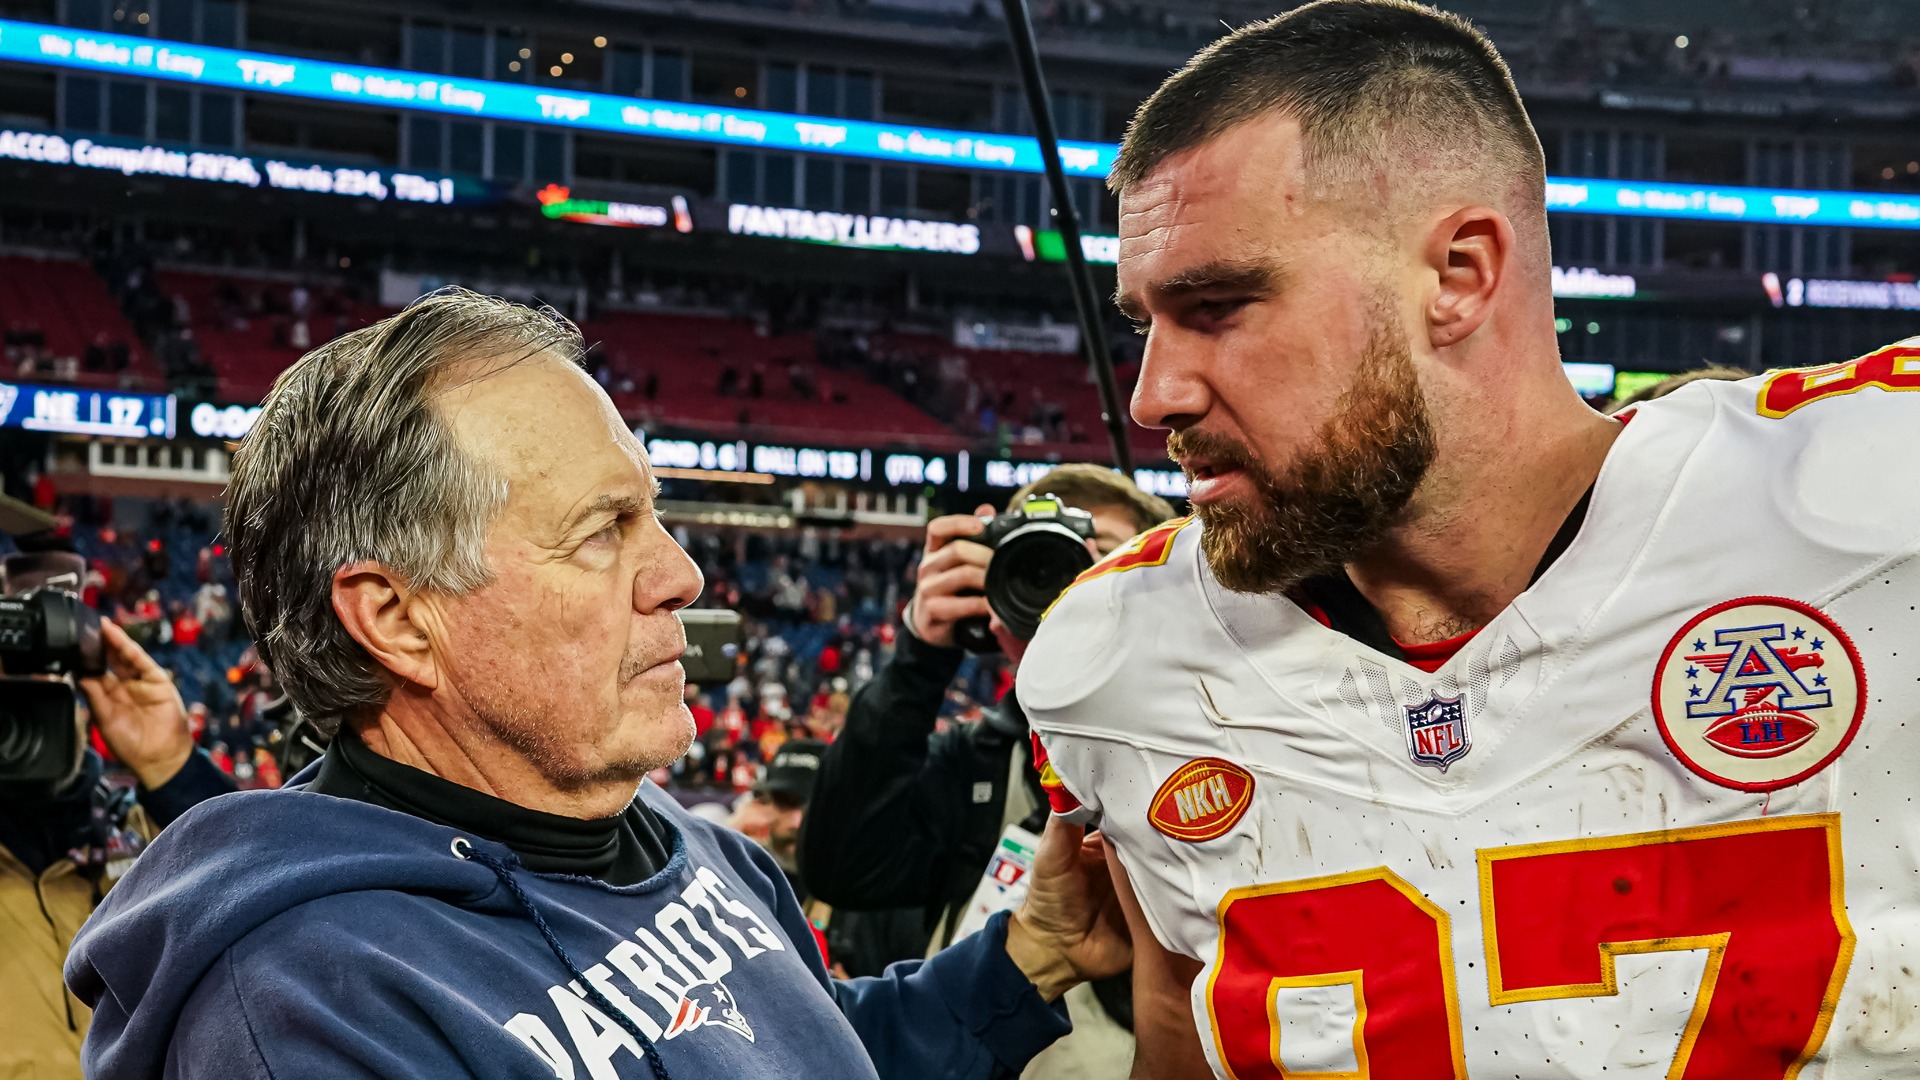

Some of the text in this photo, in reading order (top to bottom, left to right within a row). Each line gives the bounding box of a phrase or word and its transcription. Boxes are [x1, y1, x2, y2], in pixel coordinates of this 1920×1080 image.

[40, 34, 72, 57] We
[75, 38, 131, 65] Make
[157, 48, 205, 78] Easy
[331, 72, 362, 94] We
[363, 75, 417, 99] Make
[440, 84, 485, 110] Easy
[723, 115, 767, 142] Easy
[265, 160, 333, 193] Yards
[727, 203, 980, 255] FANTASY LEADERS
[34, 390, 145, 426] NE 17
[753, 444, 797, 475] BALL
[797, 447, 828, 478] ON
[884, 454, 946, 486] QTR 4
[1414, 722, 1461, 757] NFL
[1738, 721, 1786, 745] LH
[1173, 772, 1232, 824] NKH
